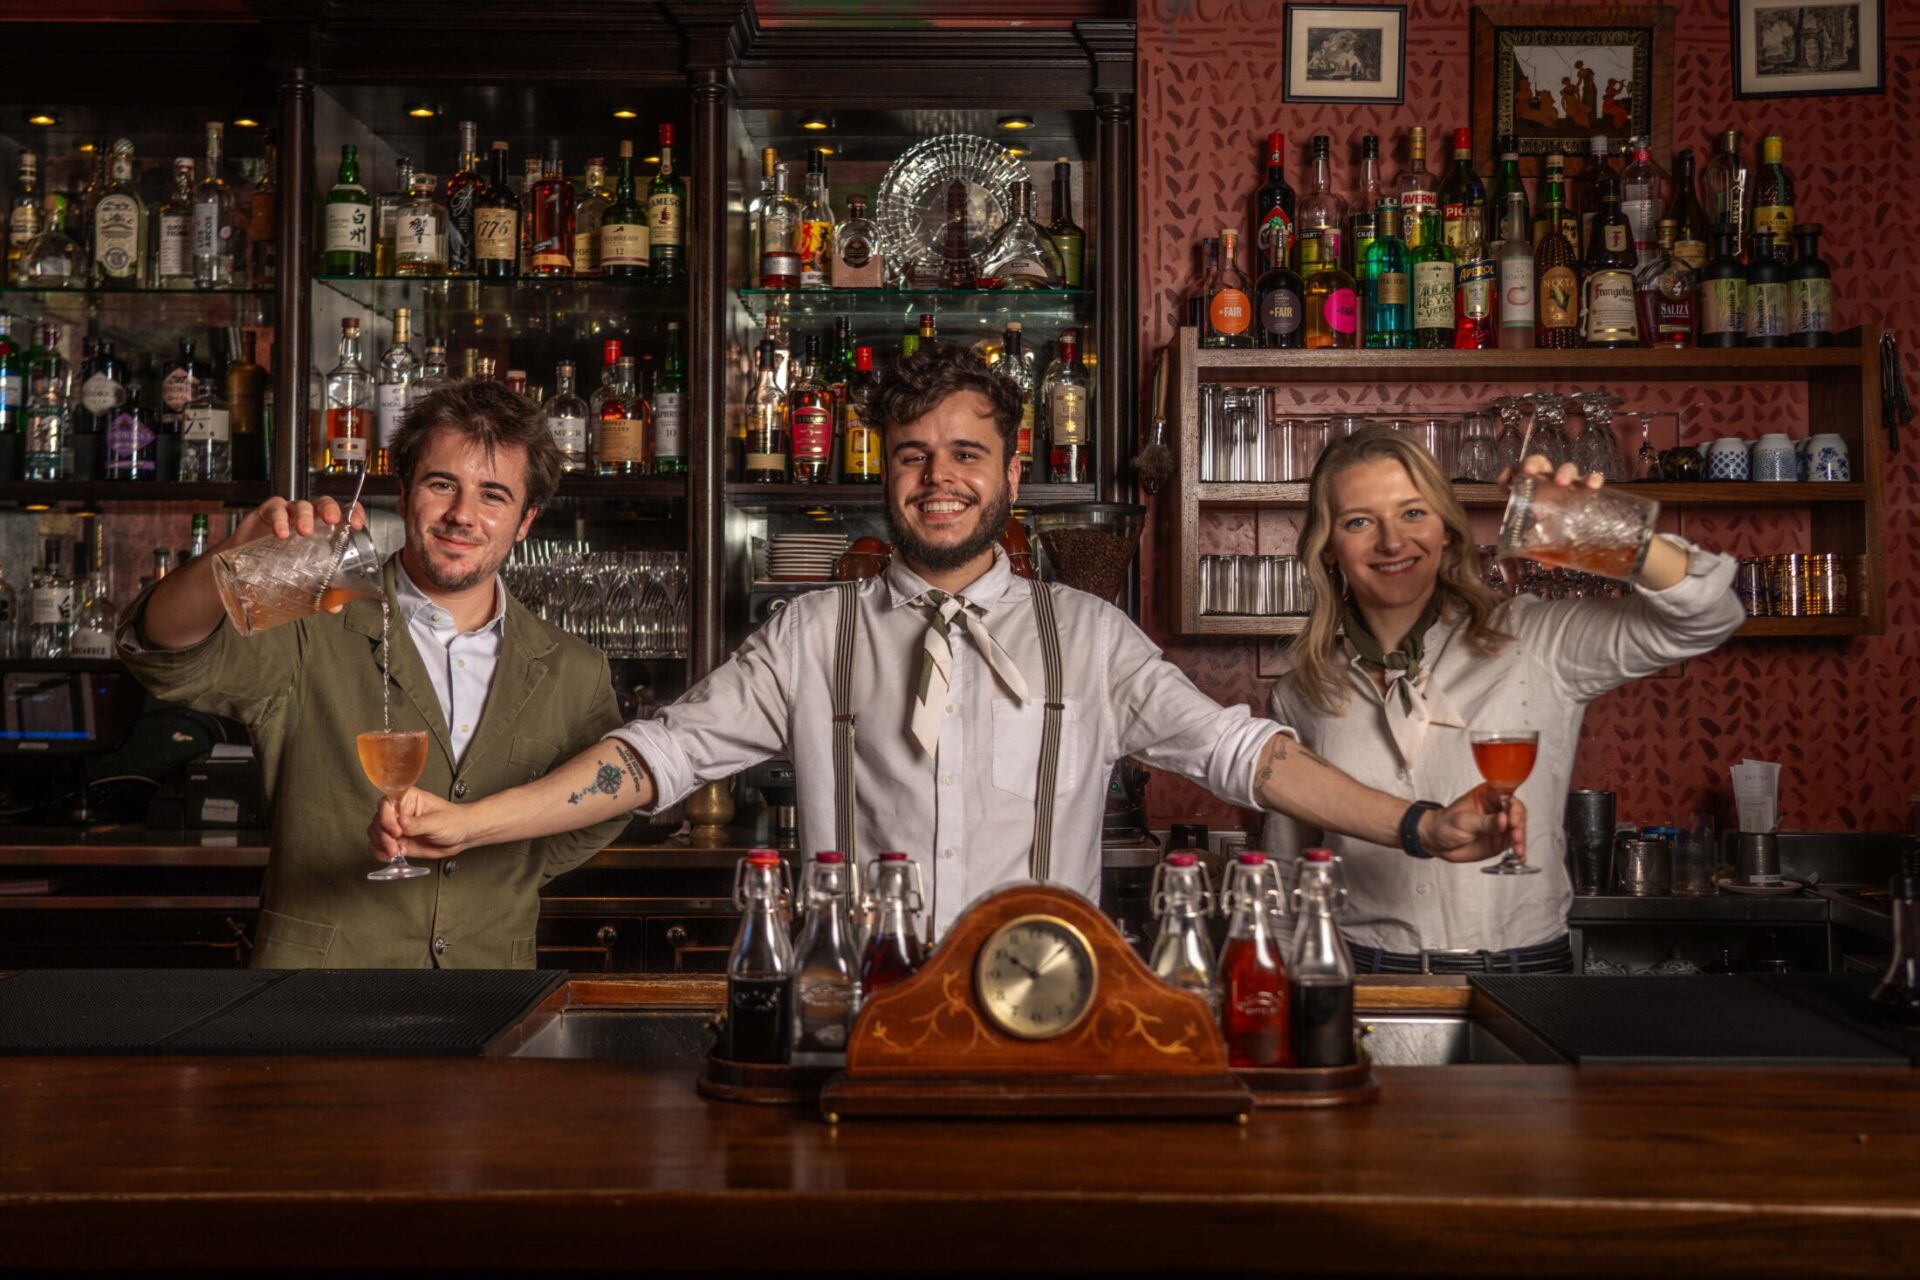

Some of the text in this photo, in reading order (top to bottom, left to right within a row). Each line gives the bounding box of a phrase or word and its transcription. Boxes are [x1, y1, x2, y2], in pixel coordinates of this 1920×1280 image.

[650, 197, 685, 208] AMESO
[205, 215, 213, 247] ARCOS
[350, 208, 366, 245] 白州
[477, 220, 512, 239] 1776
[1459, 264, 1494, 281] APEROL
[1543, 280, 1576, 288] NIXTA
[1224, 306, 1242, 317] FAIR
[1274, 306, 1293, 317] FAIR
